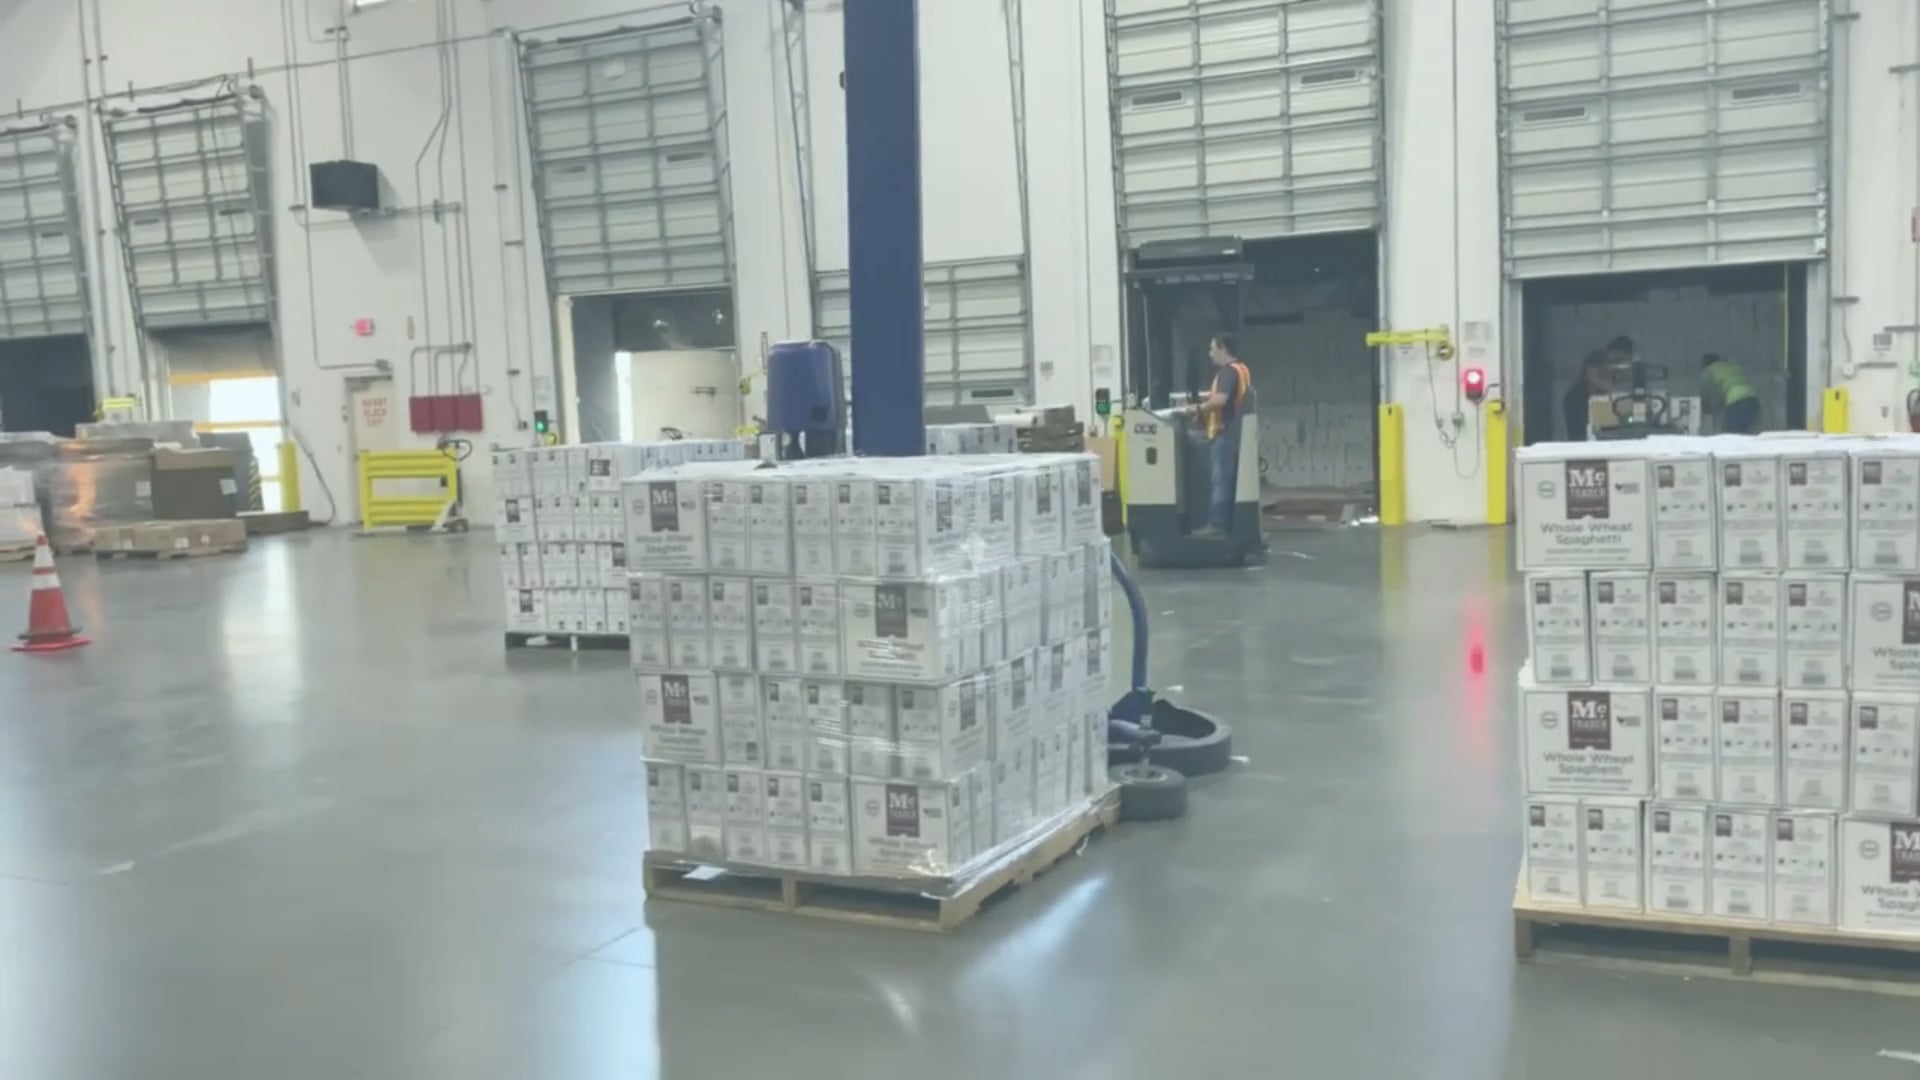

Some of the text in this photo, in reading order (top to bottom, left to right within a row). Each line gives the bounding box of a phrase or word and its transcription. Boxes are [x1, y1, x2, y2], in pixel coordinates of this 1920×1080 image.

[1540, 521, 1632, 533] Whole Wheat
[1555, 534, 1622, 546] Spaghetti
[1542, 751, 1635, 764] Whole Wheat
[1557, 763, 1623, 776] Spaghetti
[1860, 884, 1909, 898] Whole
